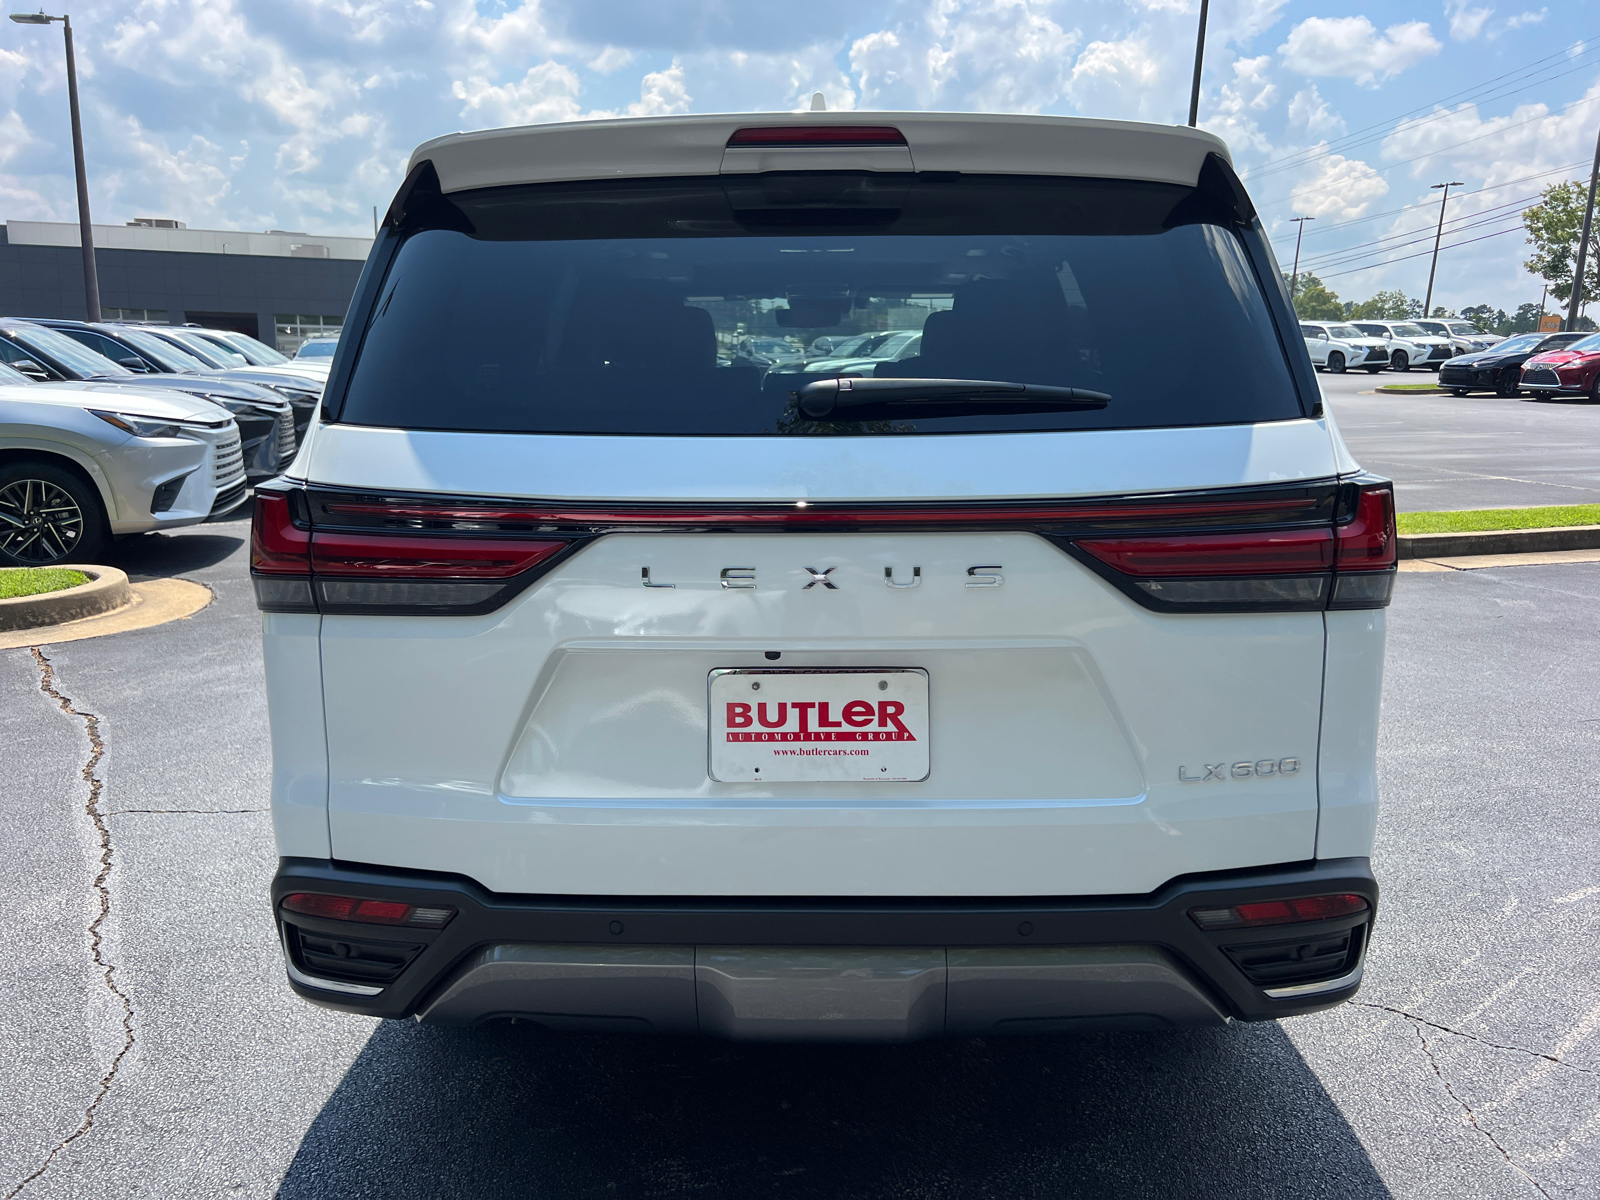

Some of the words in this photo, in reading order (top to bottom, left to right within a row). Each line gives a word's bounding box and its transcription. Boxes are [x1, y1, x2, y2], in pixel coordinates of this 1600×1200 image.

[641, 565, 1004, 590] LEXUS
[727, 732, 837, 741] AUTOMOTIVE
[855, 732, 909, 741] GROUP
[773, 747, 869, 757] www.butlercars.com
